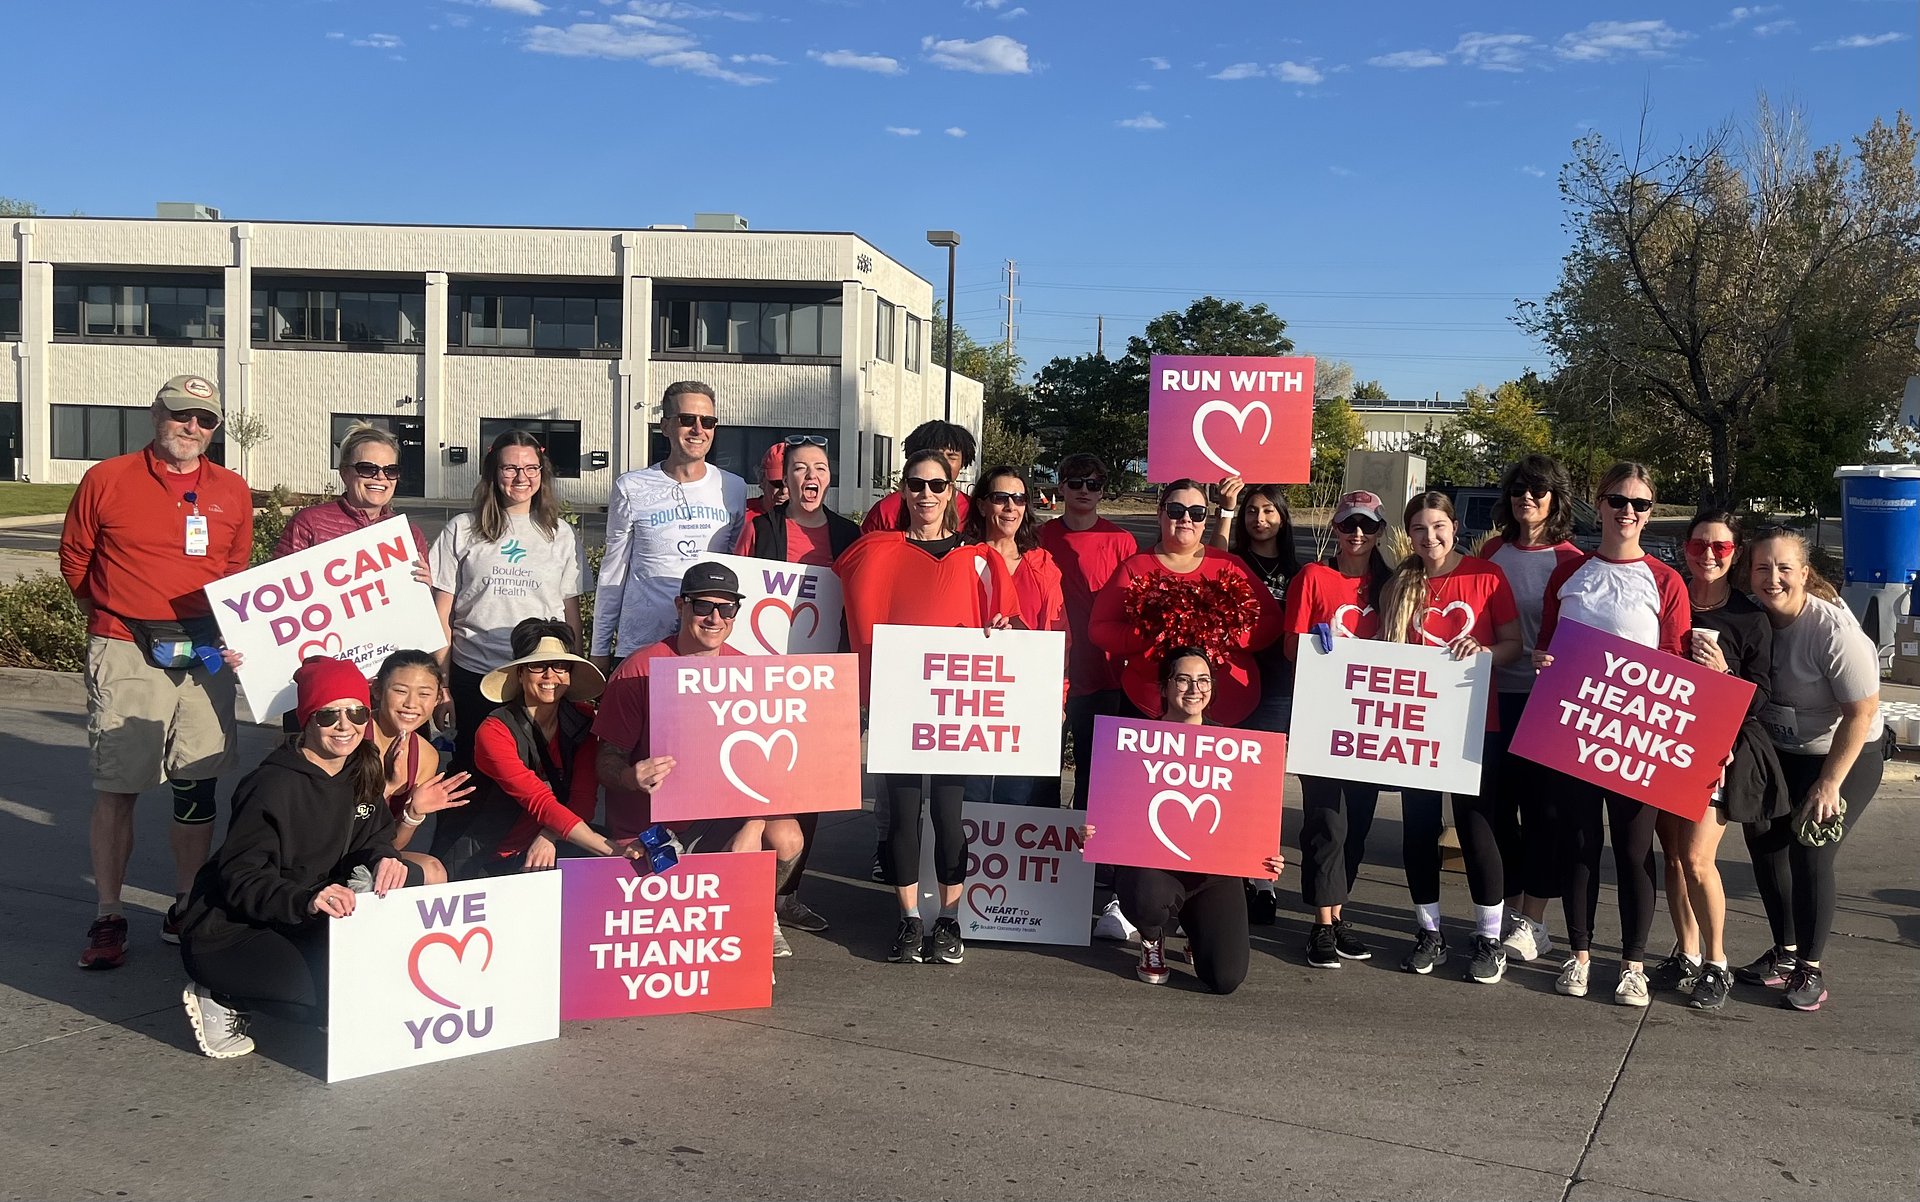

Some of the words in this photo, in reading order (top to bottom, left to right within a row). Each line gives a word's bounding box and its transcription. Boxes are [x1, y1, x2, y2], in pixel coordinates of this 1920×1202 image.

[1162, 369, 1221, 391] RUN
[1229, 370, 1303, 392] WITH
[222, 571, 314, 622] YOU
[324, 536, 409, 587] CAN
[481, 576, 542, 590] Community
[492, 565, 533, 577] Boulder
[762, 570, 818, 599] WE
[493, 585, 526, 597] Health
[270, 603, 332, 646] DO
[340, 579, 390, 620] IT!
[333, 646, 360, 660] EART
[362, 642, 374, 651] TO
[354, 650, 374, 664] ART
[376, 643, 389, 656] 5K
[677, 667, 753, 694] RUN
[764, 665, 835, 691] FOR
[923, 653, 1015, 683] FEEL
[1345, 663, 1438, 699] FEEL
[1604, 651, 1696, 706] YOUR
[707, 698, 807, 726] YOUR
[930, 688, 1005, 717] THE
[1351, 697, 1426, 732] THE
[1577, 676, 1697, 735] HEART
[912, 723, 1021, 752] BEAT!
[1117, 727, 1186, 757] RUN
[1195, 735, 1262, 764] FOR
[1330, 729, 1440, 768] BEAT!
[1559, 699, 1696, 769] THANKS
[1142, 759, 1233, 791] YOUR
[1577, 737, 1657, 787] YOU!
[962, 819, 1005, 847] OU
[1015, 823, 1084, 852] CAN
[1018, 855, 1060, 883] IT!
[616, 873, 720, 903] YOUR
[416, 892, 486, 930] WE
[604, 905, 731, 936] HEART
[984, 905, 1019, 915] HEART
[994, 915, 1027, 925] HEART
[1029, 917, 1043, 926] 5K
[589, 936, 742, 969] THANKS
[620, 970, 710, 1000] YOU!
[404, 1006, 493, 1050] YOU
